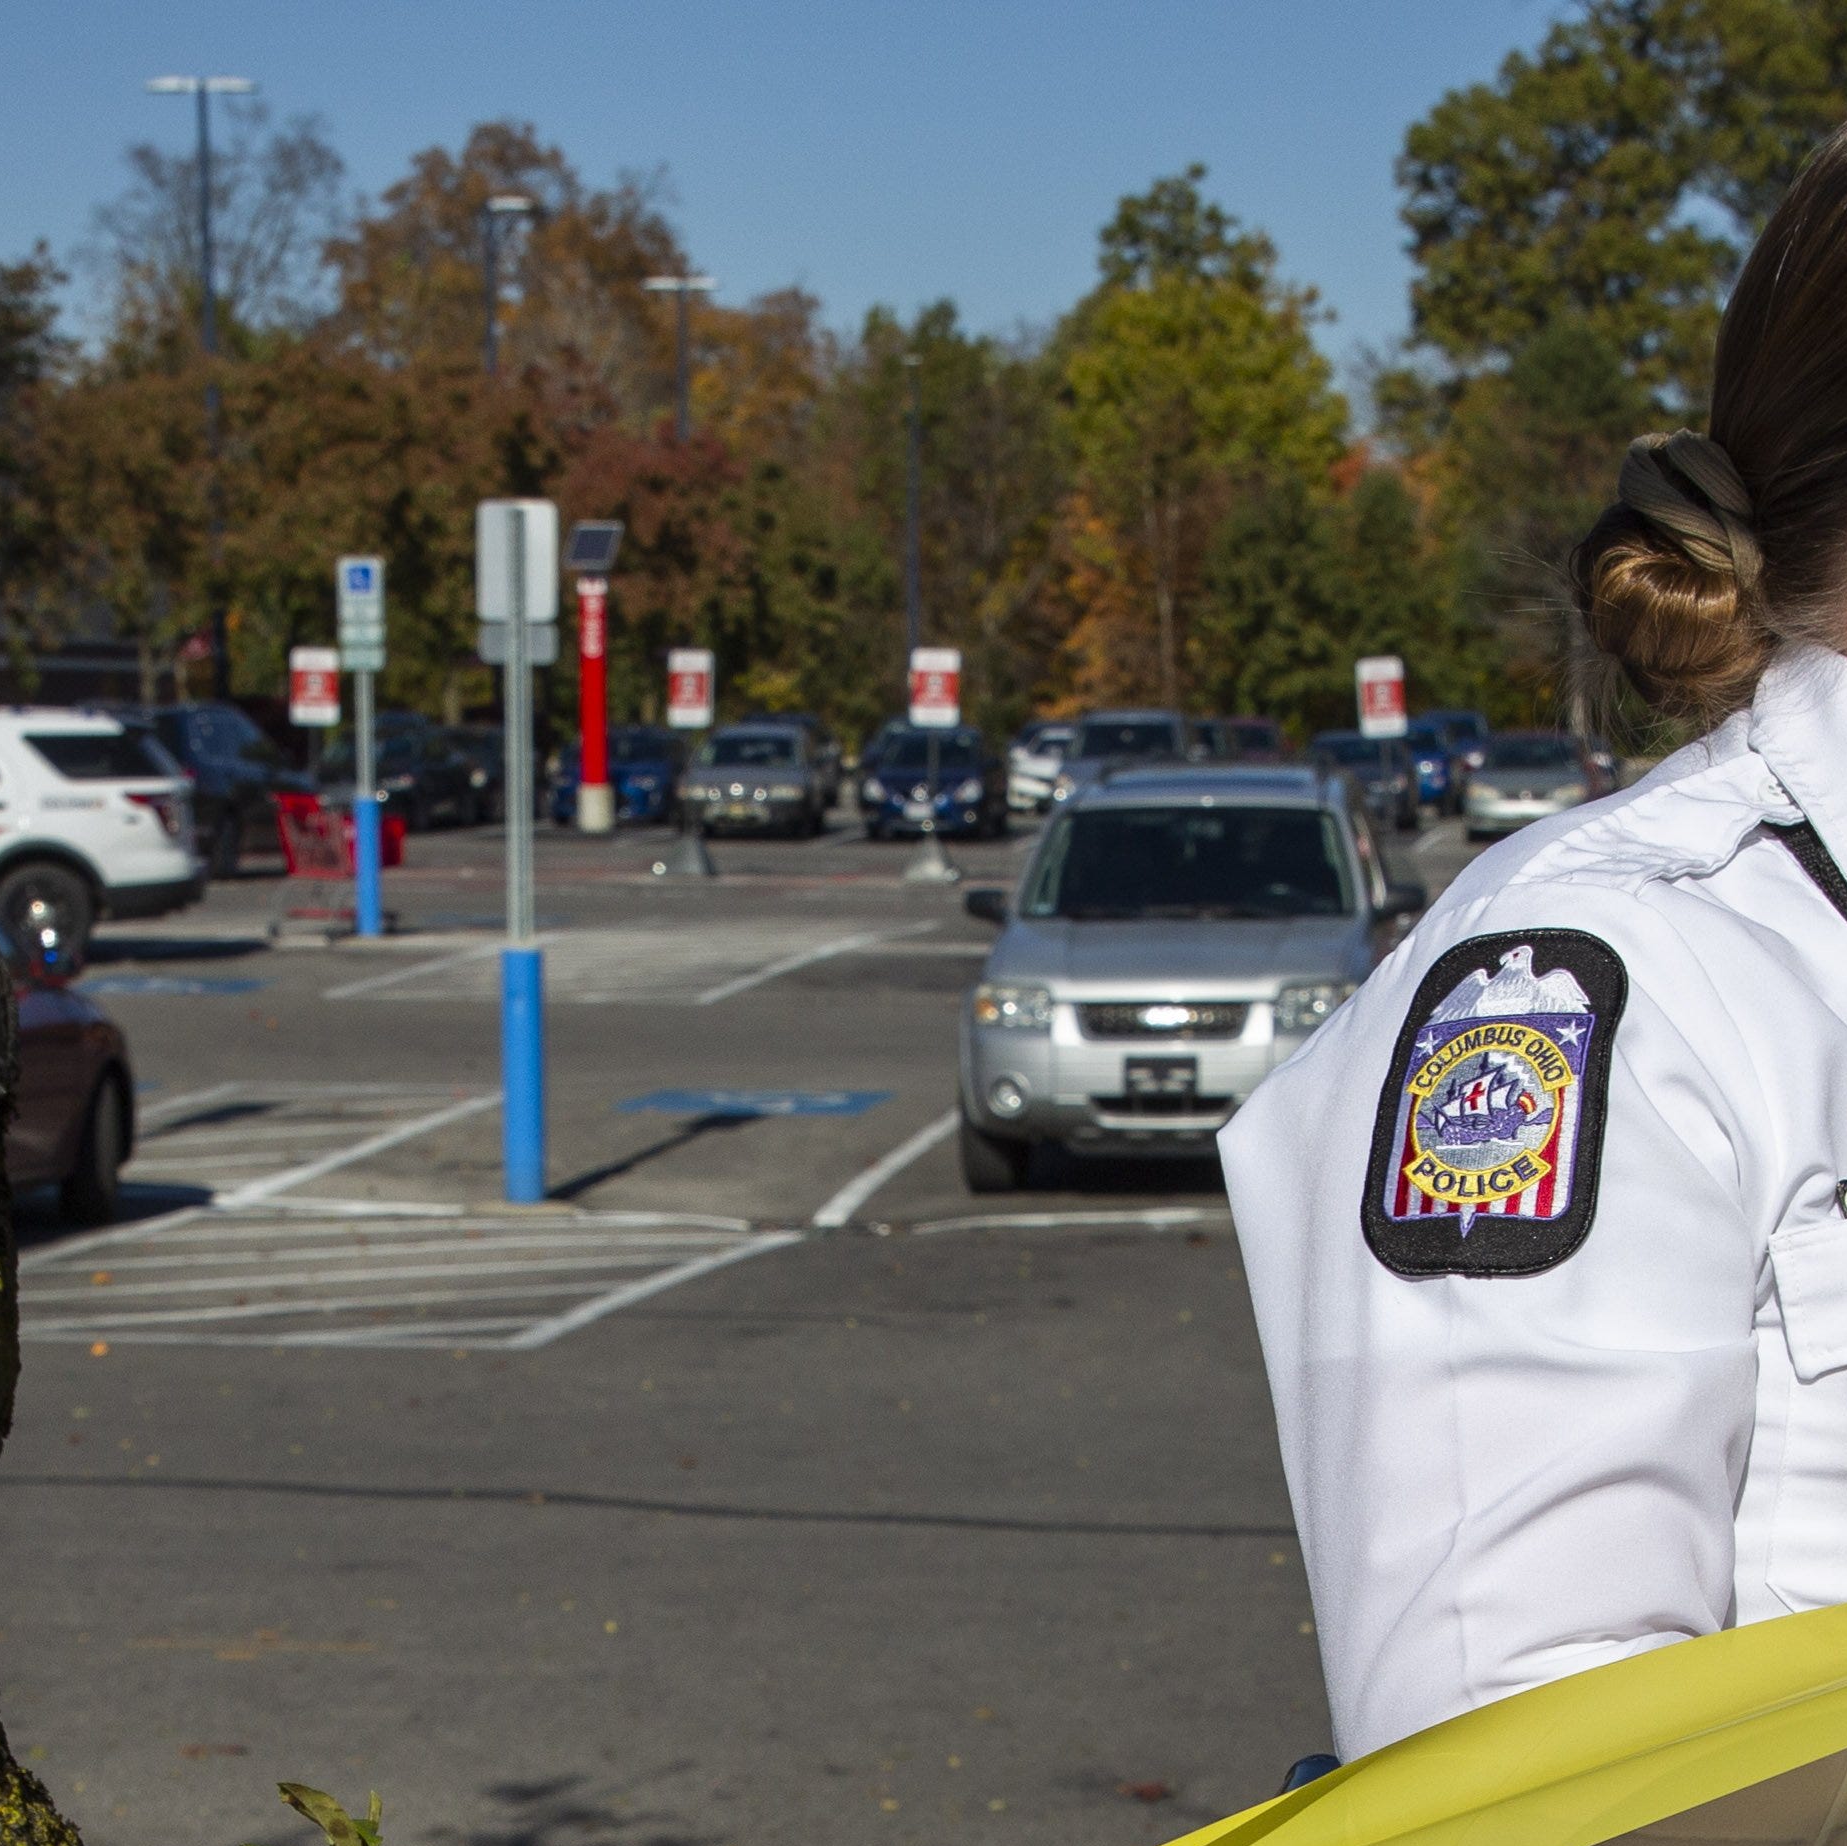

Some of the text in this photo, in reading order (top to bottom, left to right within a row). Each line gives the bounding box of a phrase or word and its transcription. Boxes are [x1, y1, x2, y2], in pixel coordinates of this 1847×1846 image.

[1415, 1027, 1565, 1088] COLUMBUS OHIO
[1412, 1155, 1539, 1198] POLICE
